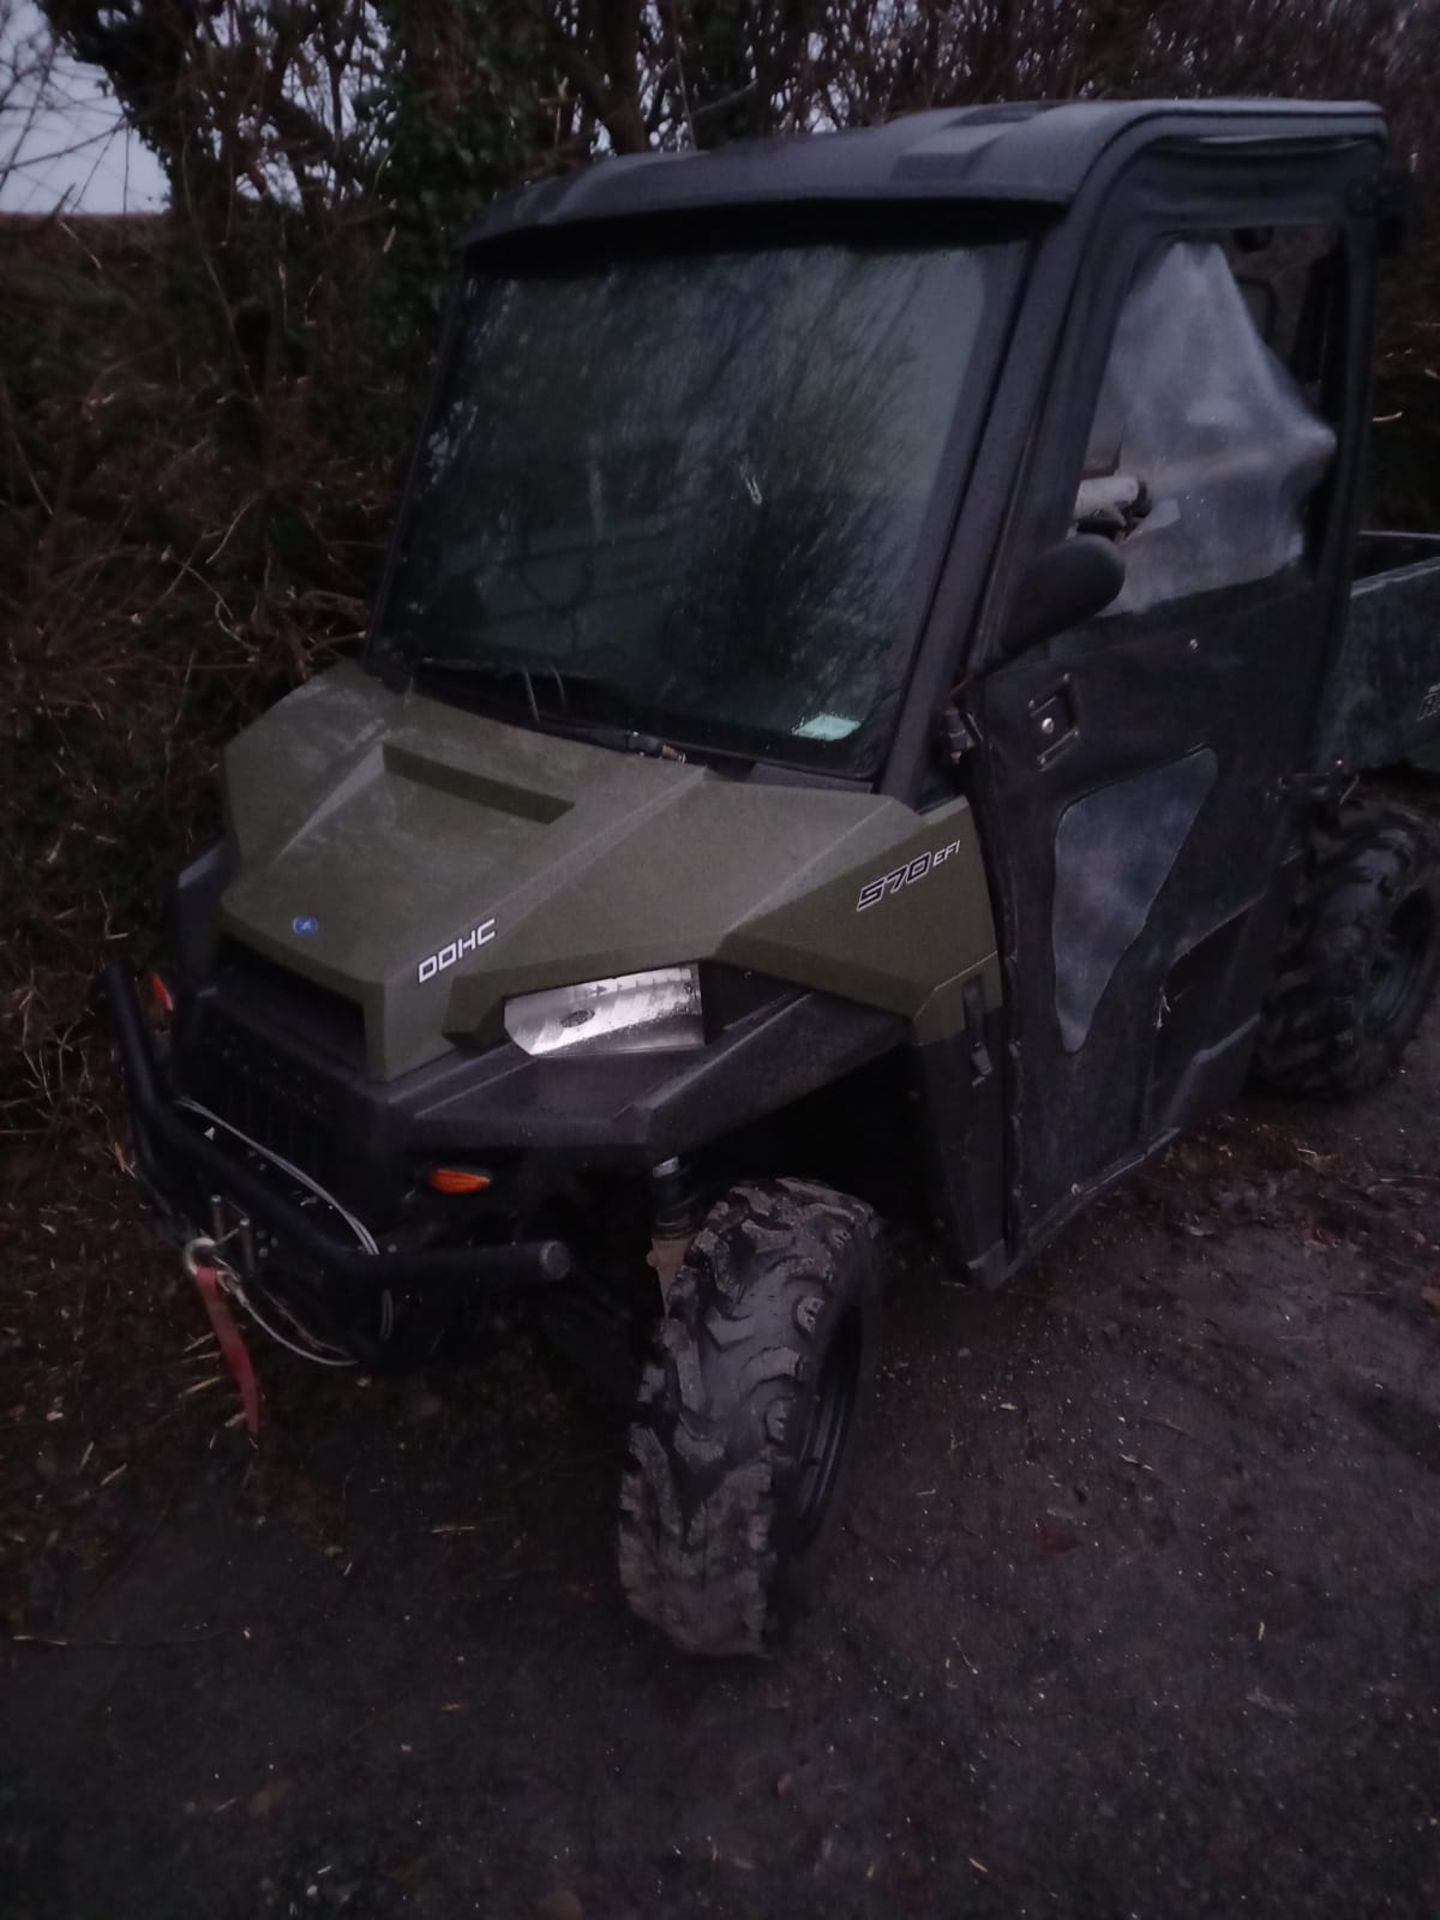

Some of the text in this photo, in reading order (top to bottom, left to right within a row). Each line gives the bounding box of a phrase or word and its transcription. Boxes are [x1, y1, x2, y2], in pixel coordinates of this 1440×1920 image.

[856, 839, 961, 912] 570 EFI
[418, 917, 496, 984] DOHC
